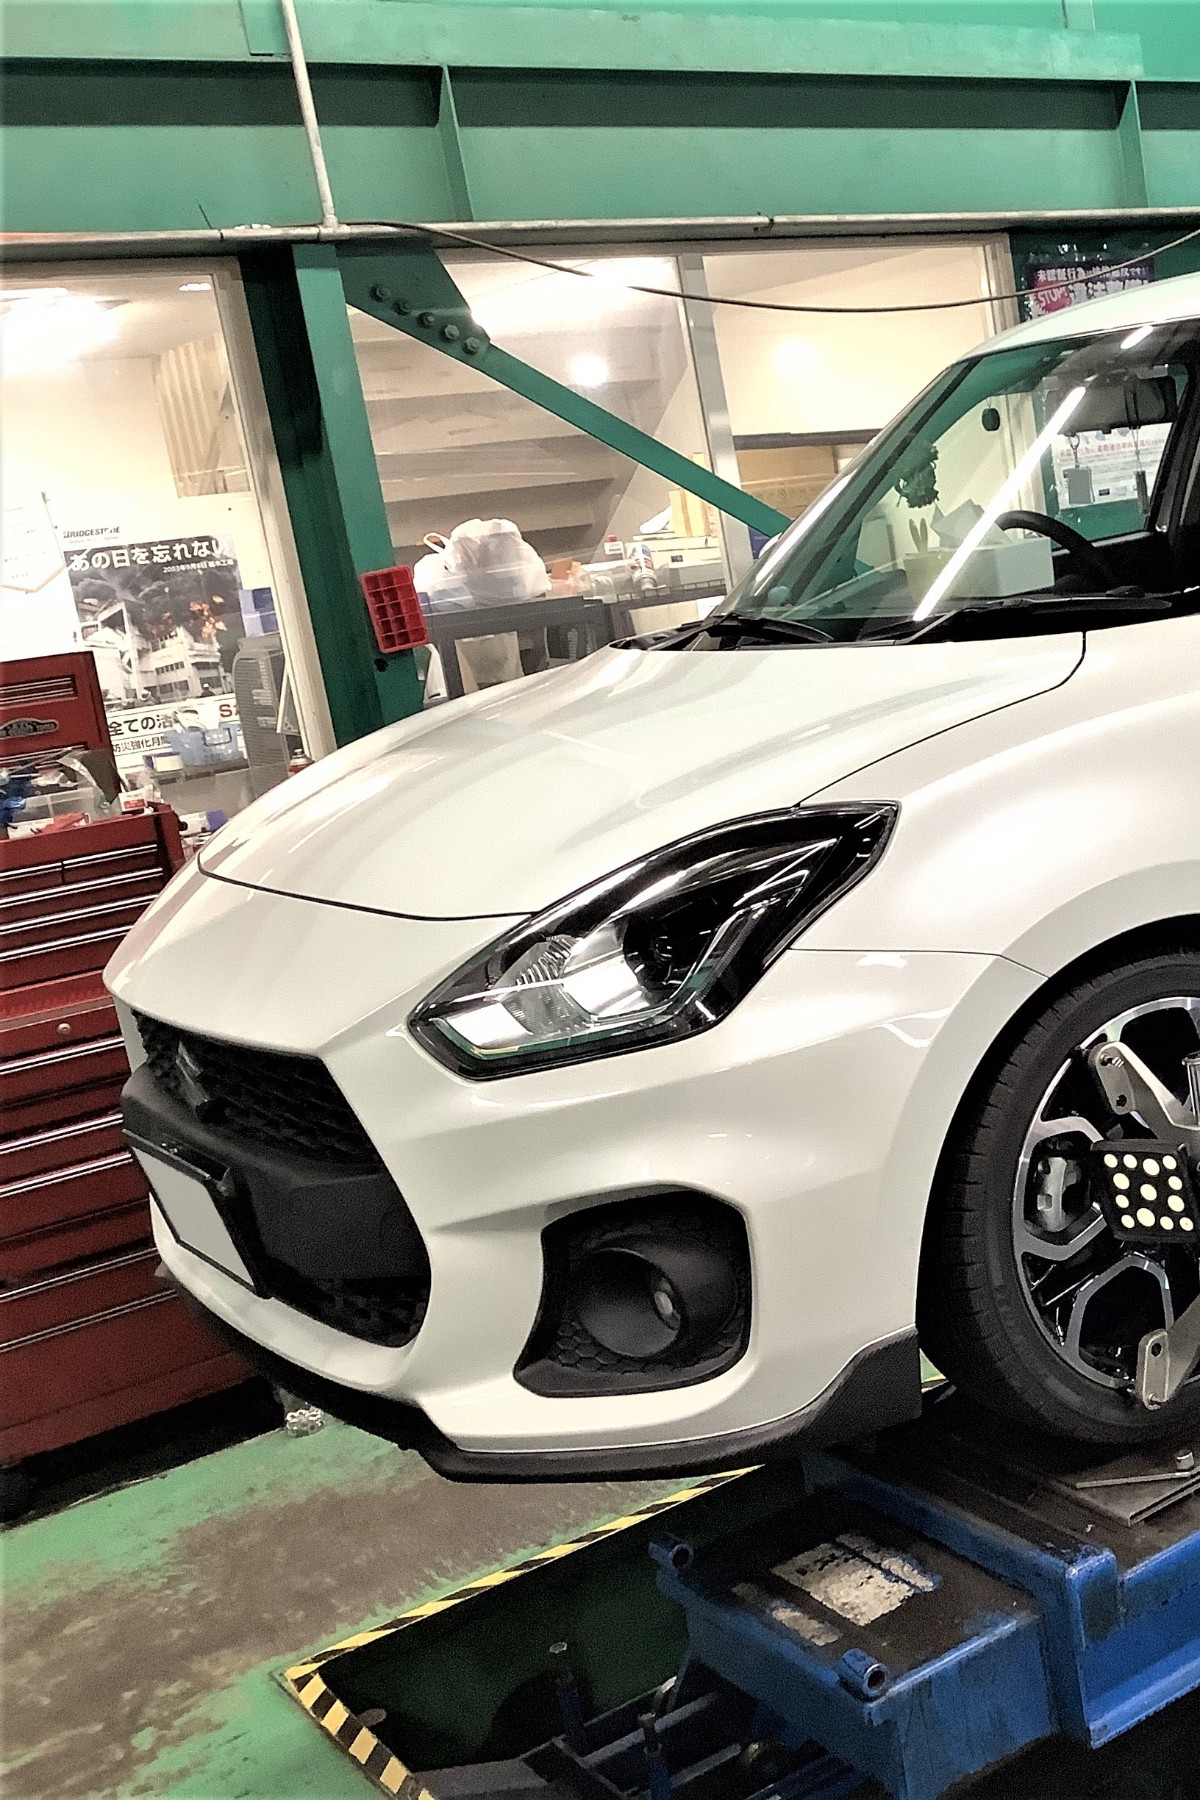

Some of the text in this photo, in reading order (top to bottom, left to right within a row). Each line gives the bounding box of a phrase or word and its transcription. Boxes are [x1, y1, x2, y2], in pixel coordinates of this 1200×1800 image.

[63, 526, 120, 539] BRIDGESTNE
[69, 539, 230, 572] あの日を忘れない
